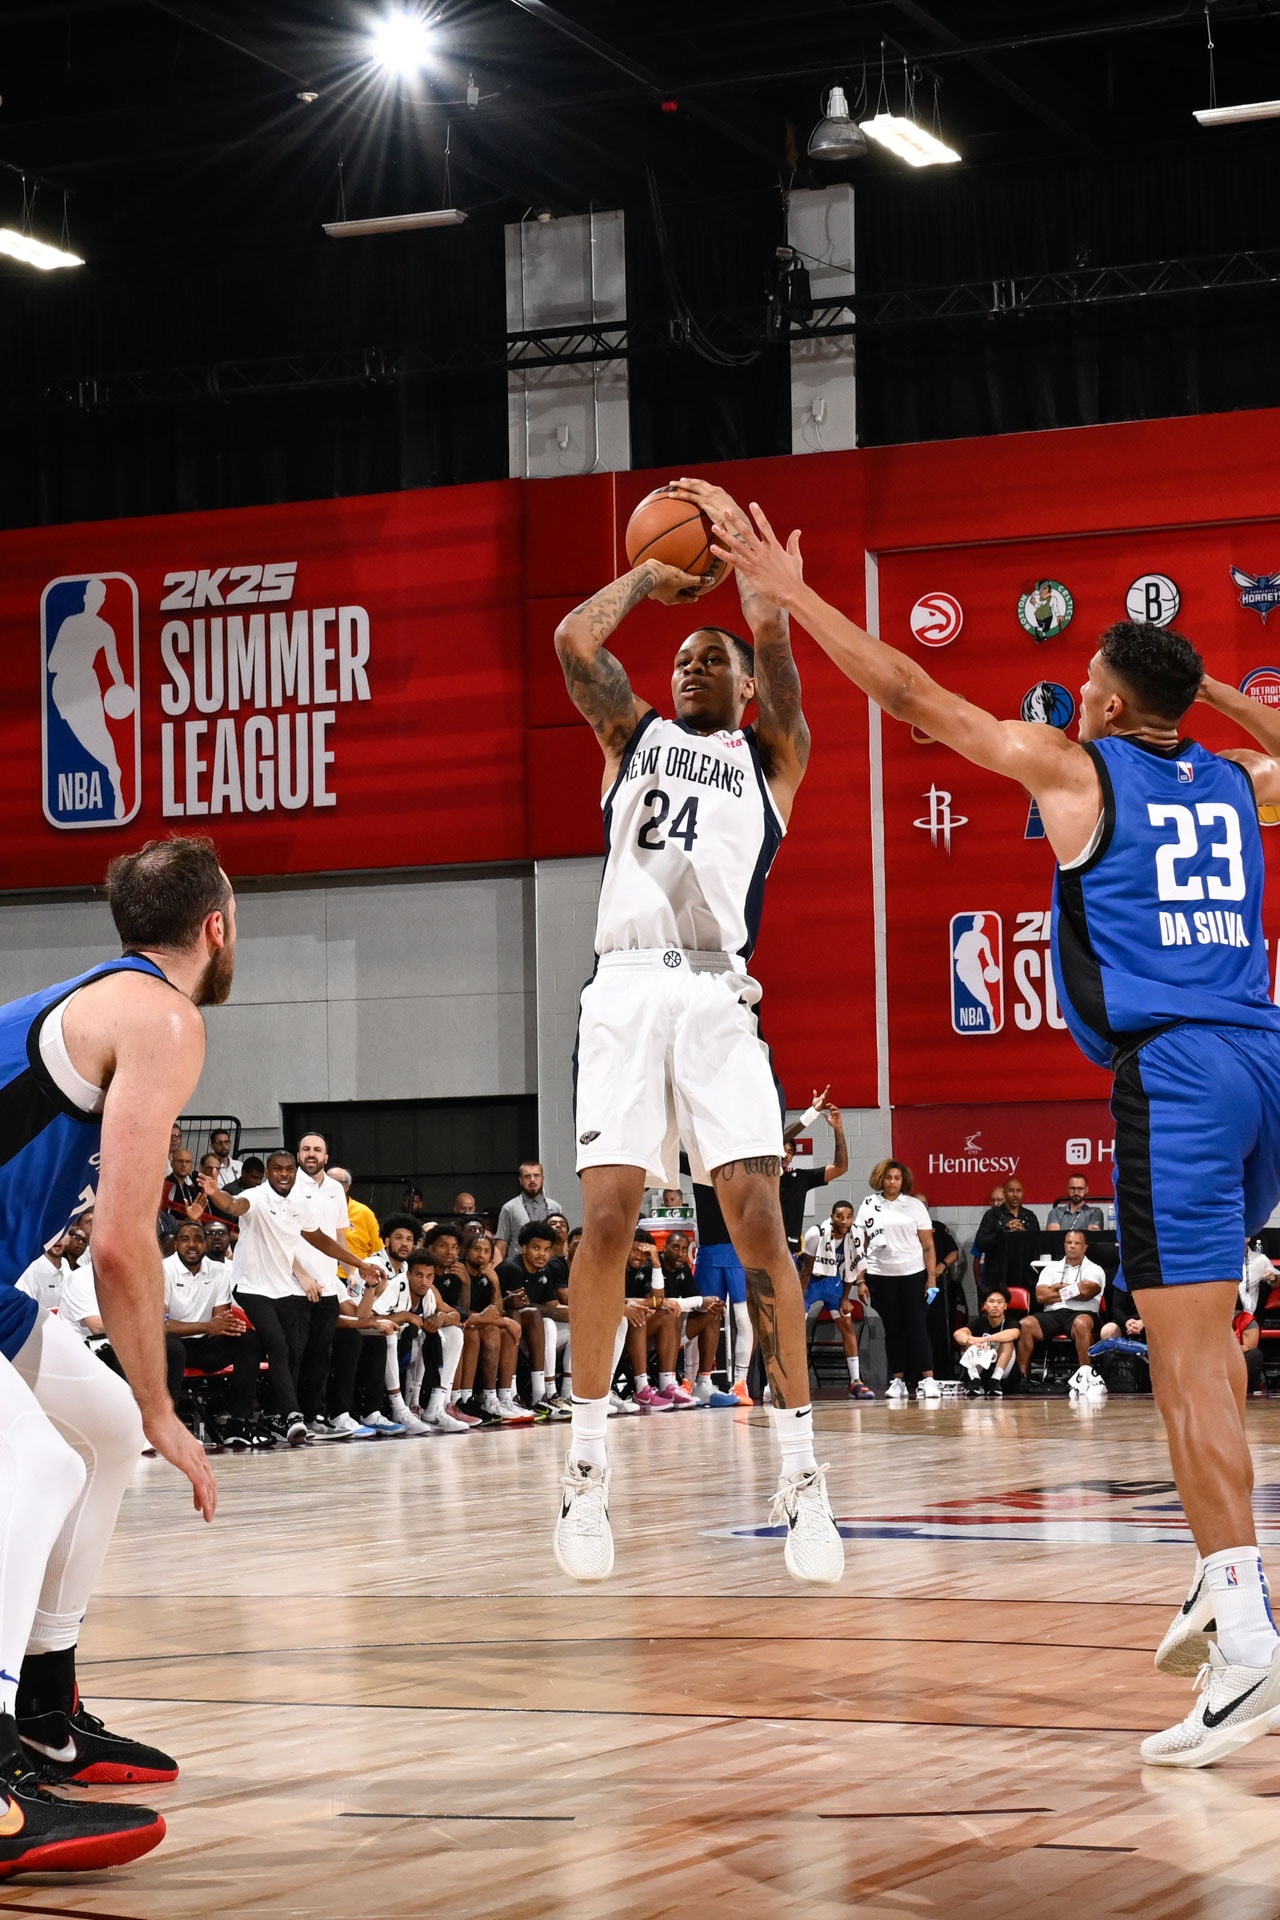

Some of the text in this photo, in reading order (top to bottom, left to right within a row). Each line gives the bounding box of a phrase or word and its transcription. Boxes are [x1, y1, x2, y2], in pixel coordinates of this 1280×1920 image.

[160, 561, 297, 610] 2K25
[1242, 592, 1280, 604] HORNET
[160, 605, 371, 716] SUMMER
[1250, 685, 1280, 696] DETROI
[161, 711, 337, 817] LEAGUE
[665, 746, 745, 798] ORLEANS
[58, 771, 103, 812] NBA
[637, 789, 699, 851] 24
[1146, 803, 1246, 902] 23
[1159, 911, 1250, 947] DA SILVA
[960, 1007, 984, 1026] NBA
[929, 1153, 1020, 1176] Hennessy
